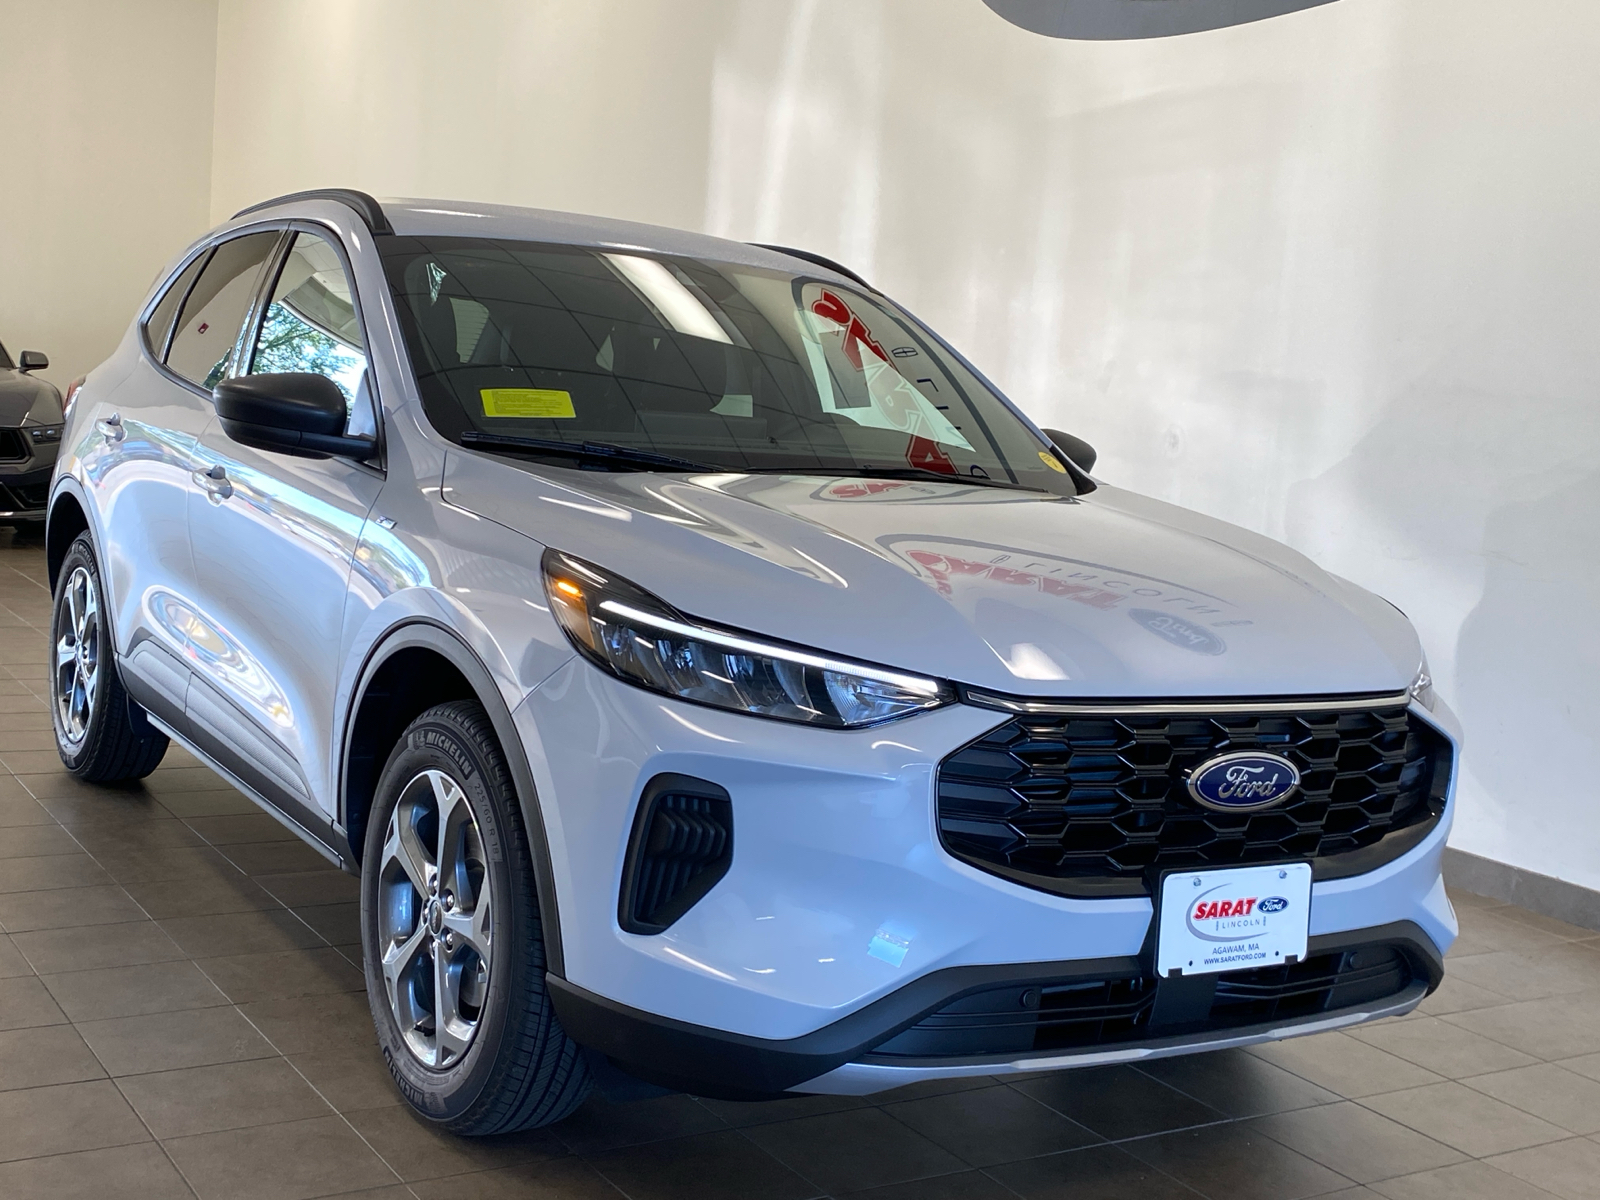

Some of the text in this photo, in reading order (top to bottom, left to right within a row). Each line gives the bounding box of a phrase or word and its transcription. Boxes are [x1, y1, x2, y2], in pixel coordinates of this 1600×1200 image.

[426, 731, 473, 776] MICHELIN
[1218, 765, 1279, 799] Ford
[474, 783, 500, 854] 225/60 R 18
[1193, 897, 1259, 921] SARAT
[1222, 918, 1260, 930] LINCOLN
[1204, 952, 1266, 965] WWW.SARATFORD.COM
[1212, 943, 1260, 955] AGAWAM, MA
